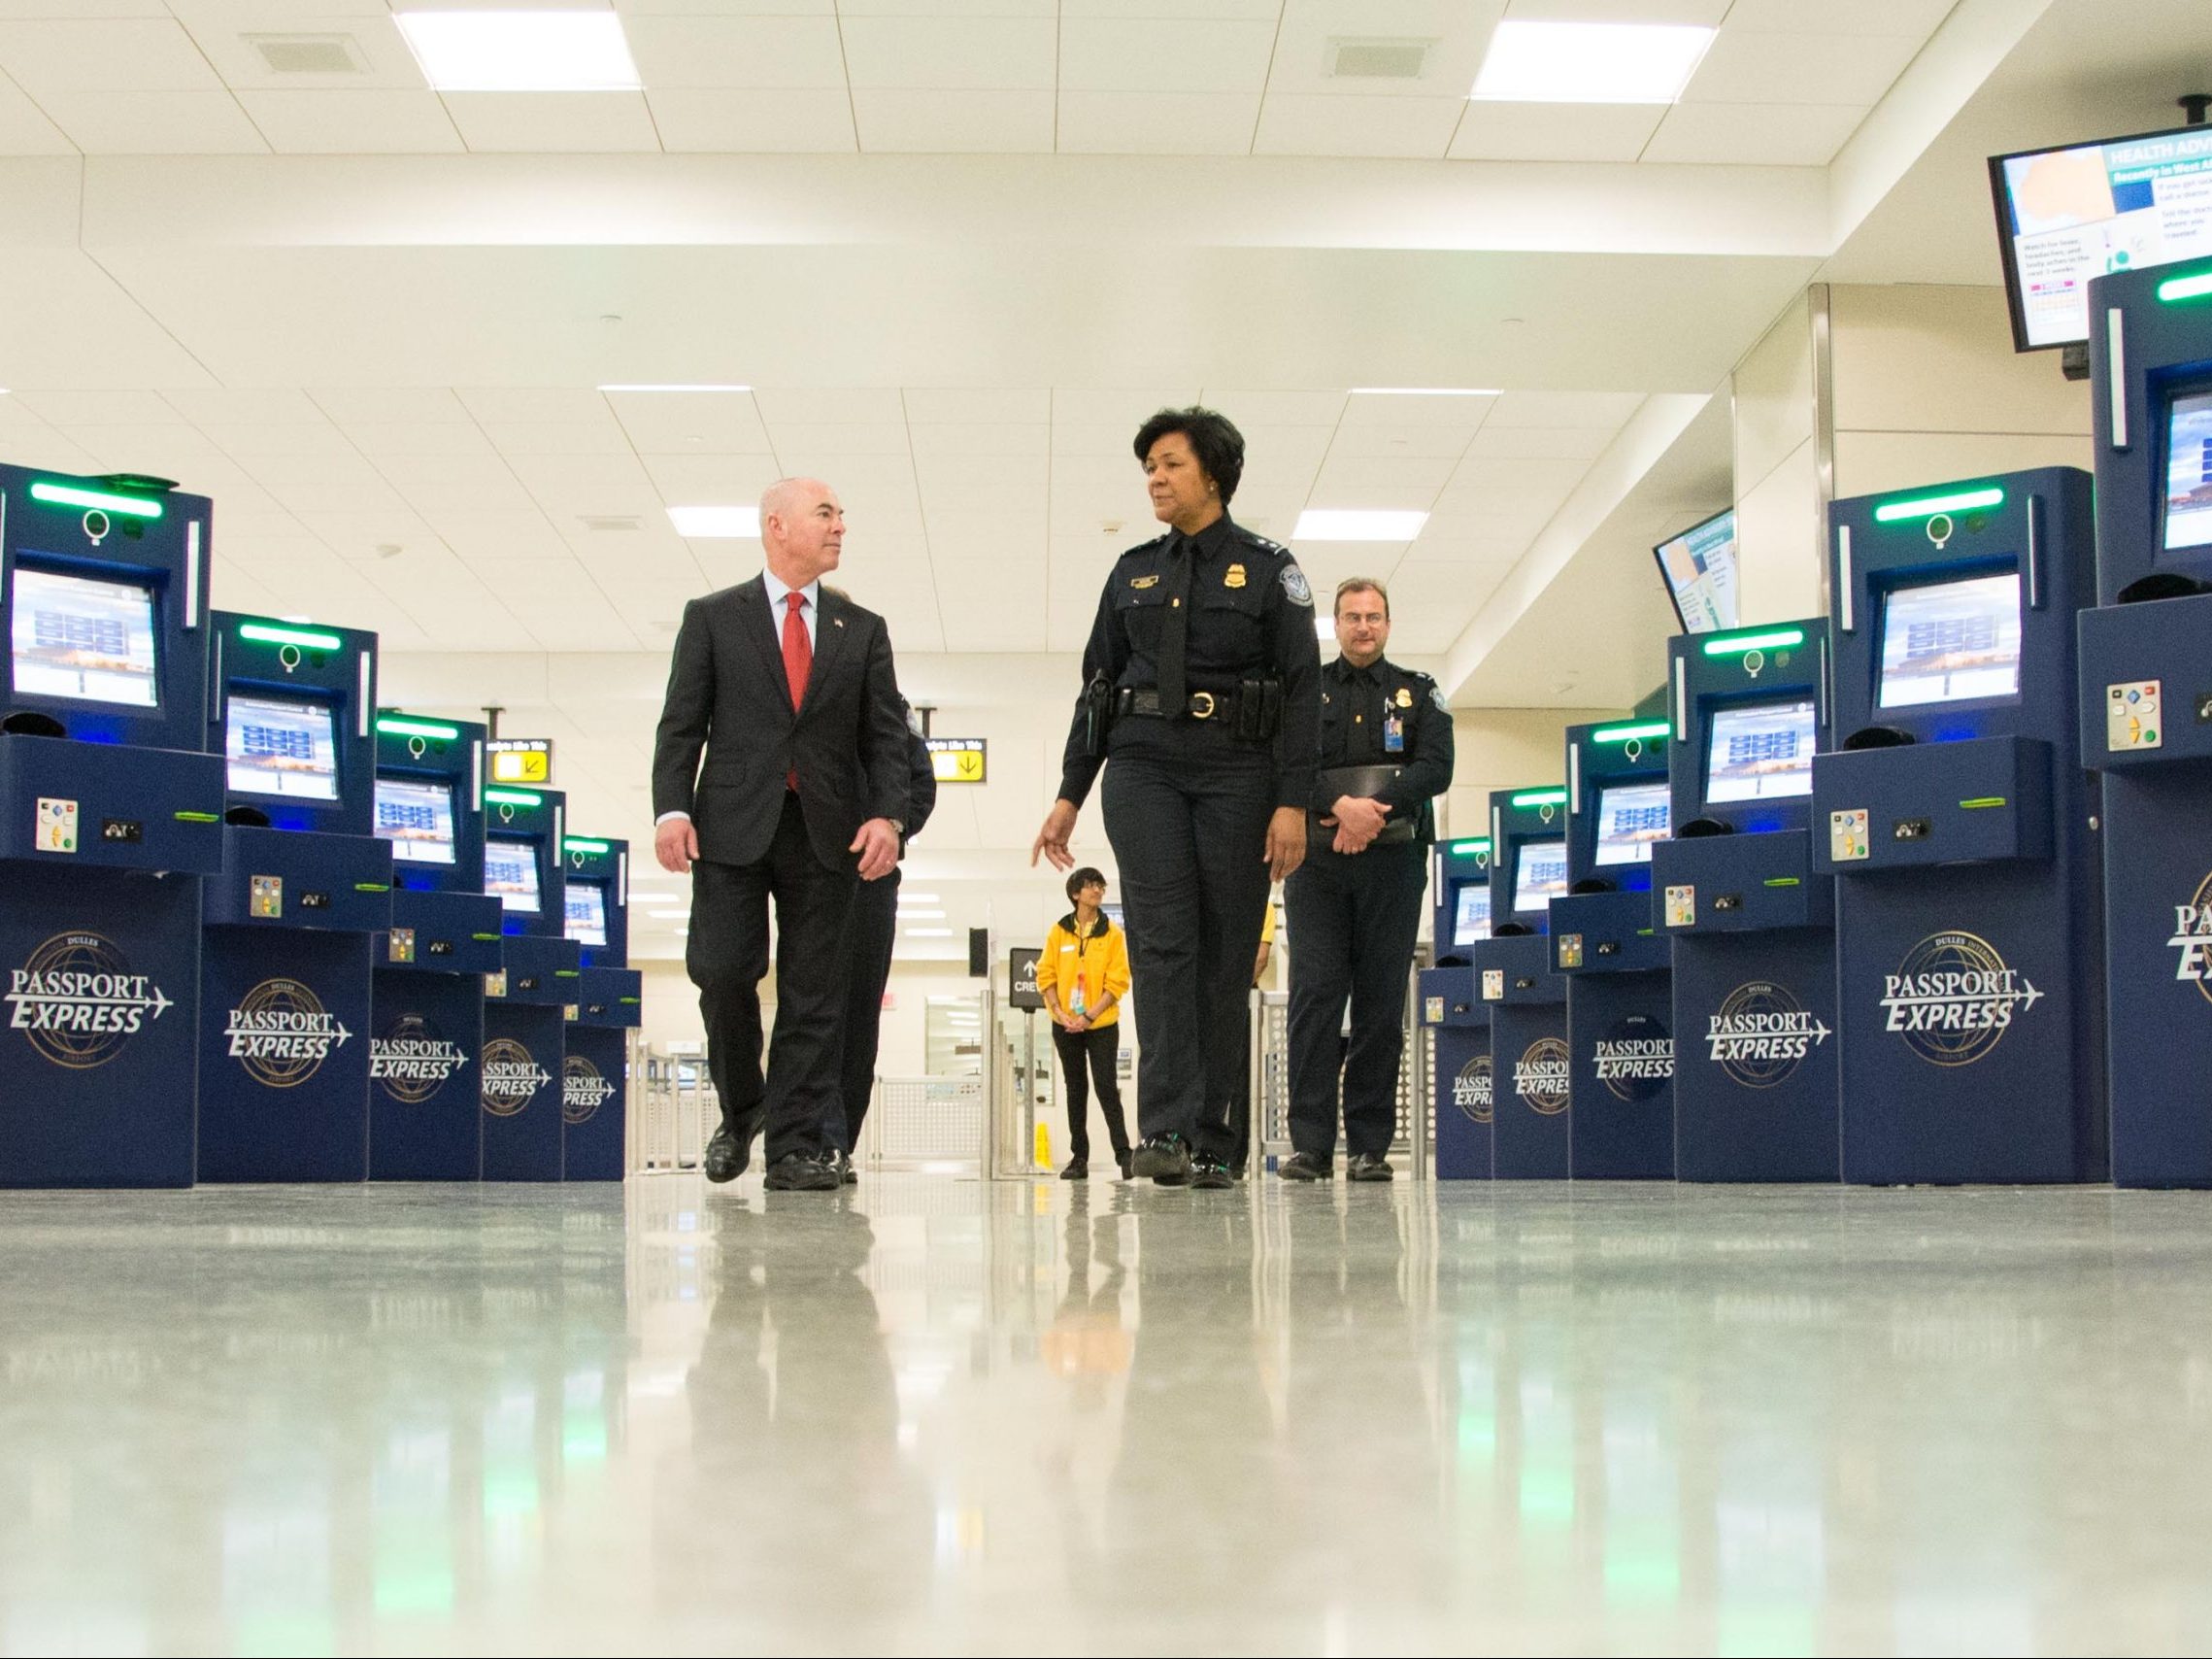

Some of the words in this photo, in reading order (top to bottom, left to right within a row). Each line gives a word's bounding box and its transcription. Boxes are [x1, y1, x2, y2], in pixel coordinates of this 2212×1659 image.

[2111, 143, 2173, 164] HEALTH
[67, 936, 99, 947] DULLES
[1935, 936, 1966, 946] DULLES
[11, 969, 149, 999] PASSPORT
[1014, 981, 1036, 992] CRE
[1885, 969, 2017, 998] PASSPORT
[11, 999, 144, 1033] EXPRESS
[228, 1010, 333, 1032] PASSPORT
[1710, 1012, 1811, 1033] PASSPORT
[1886, 1002, 2014, 1032] EXPRESS
[228, 1033, 330, 1059] EXPRESS
[371, 1039, 453, 1057] PASSPORT
[1596, 1038, 1675, 1057] PASSPORT
[1710, 1036, 1808, 1060] EXPRESS
[370, 1058, 451, 1079] EXPRESS
[483, 1062, 539, 1076] SSPORT
[1516, 1061, 1569, 1075] PASSPO
[1596, 1059, 1675, 1078] EXPRESS
[483, 1079, 537, 1096] XPRESS
[564, 1076, 605, 1089] SPORT
[1455, 1076, 1491, 1089] PASSP
[1516, 1078, 1569, 1095] EXPRE
[563, 1092, 602, 1105] PRESS
[1455, 1091, 1491, 1105] EXPR
